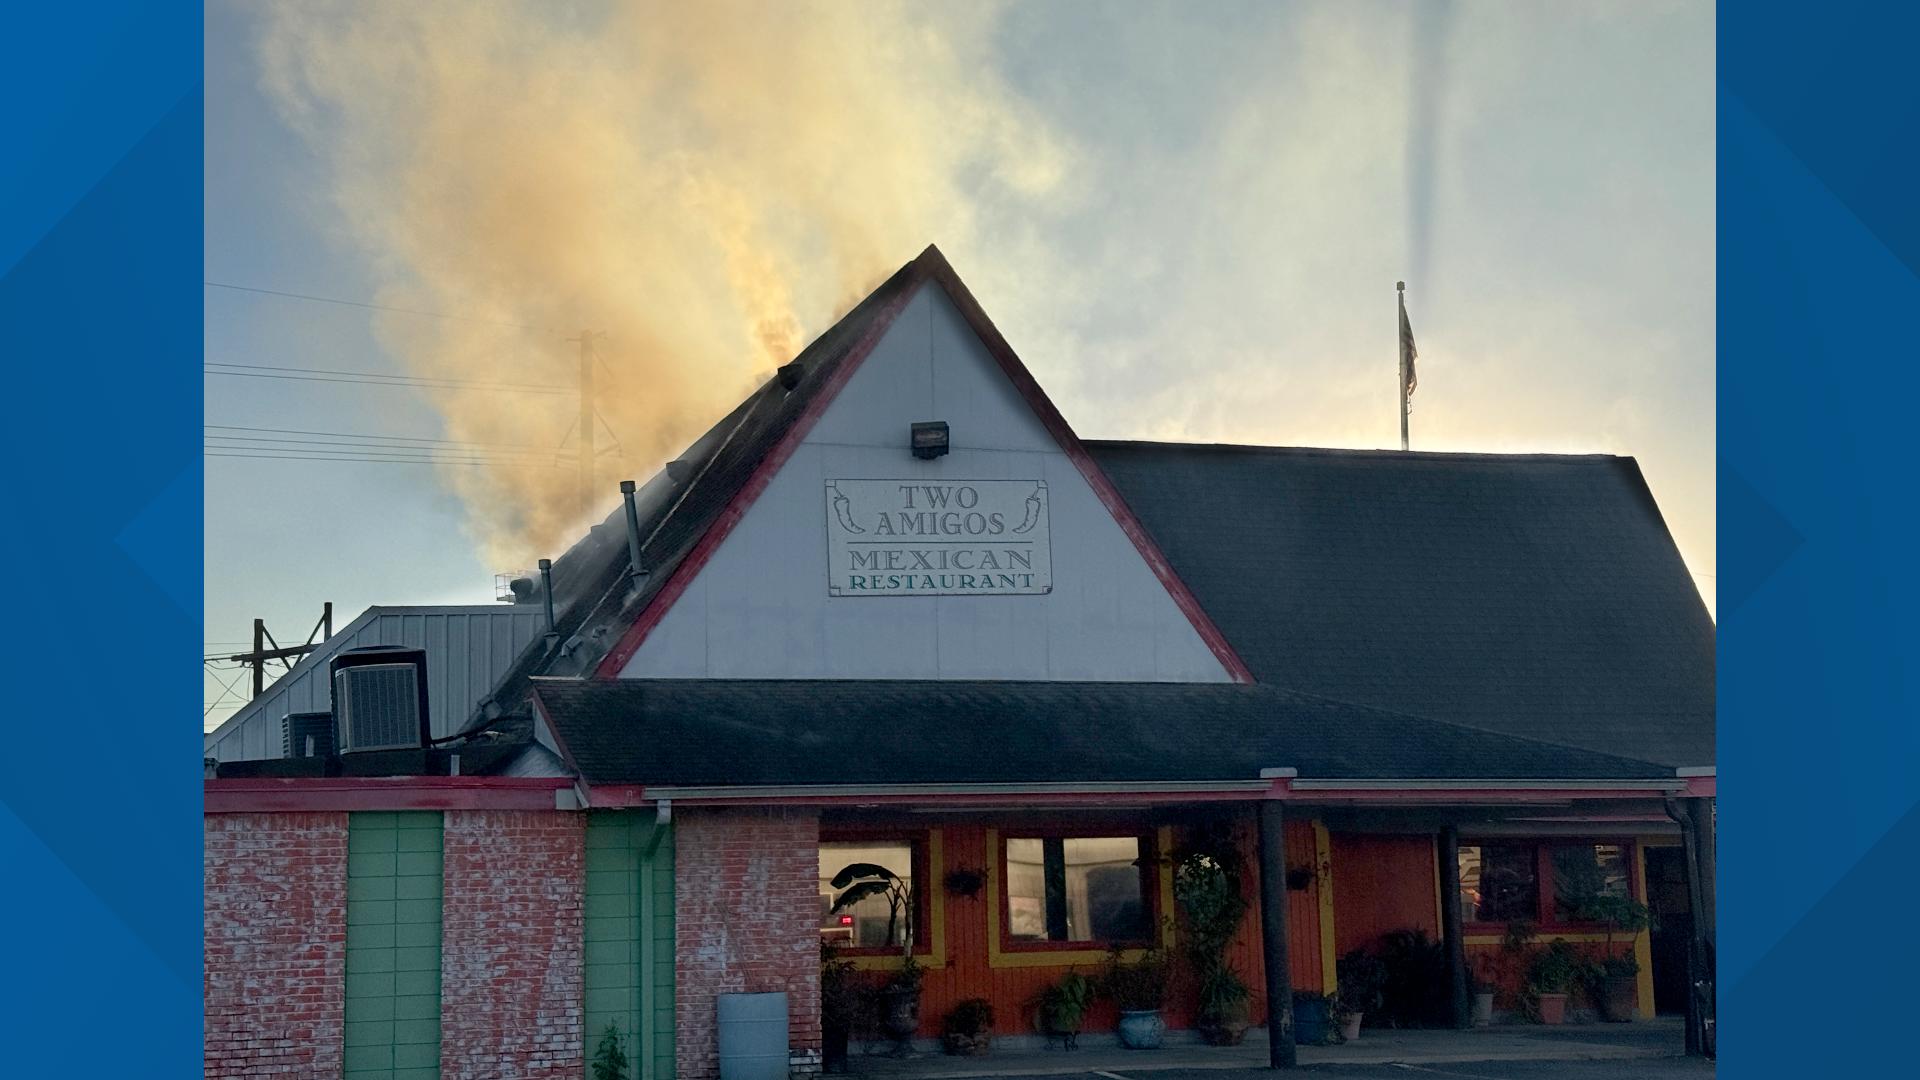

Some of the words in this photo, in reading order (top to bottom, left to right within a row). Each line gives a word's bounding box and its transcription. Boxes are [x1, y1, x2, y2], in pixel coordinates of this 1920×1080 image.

[899, 485, 979, 509] TWO
[873, 512, 1006, 536] AMIGOS
[848, 549, 1033, 571] MEXICAN
[848, 573, 1035, 590] RESTAURANT
